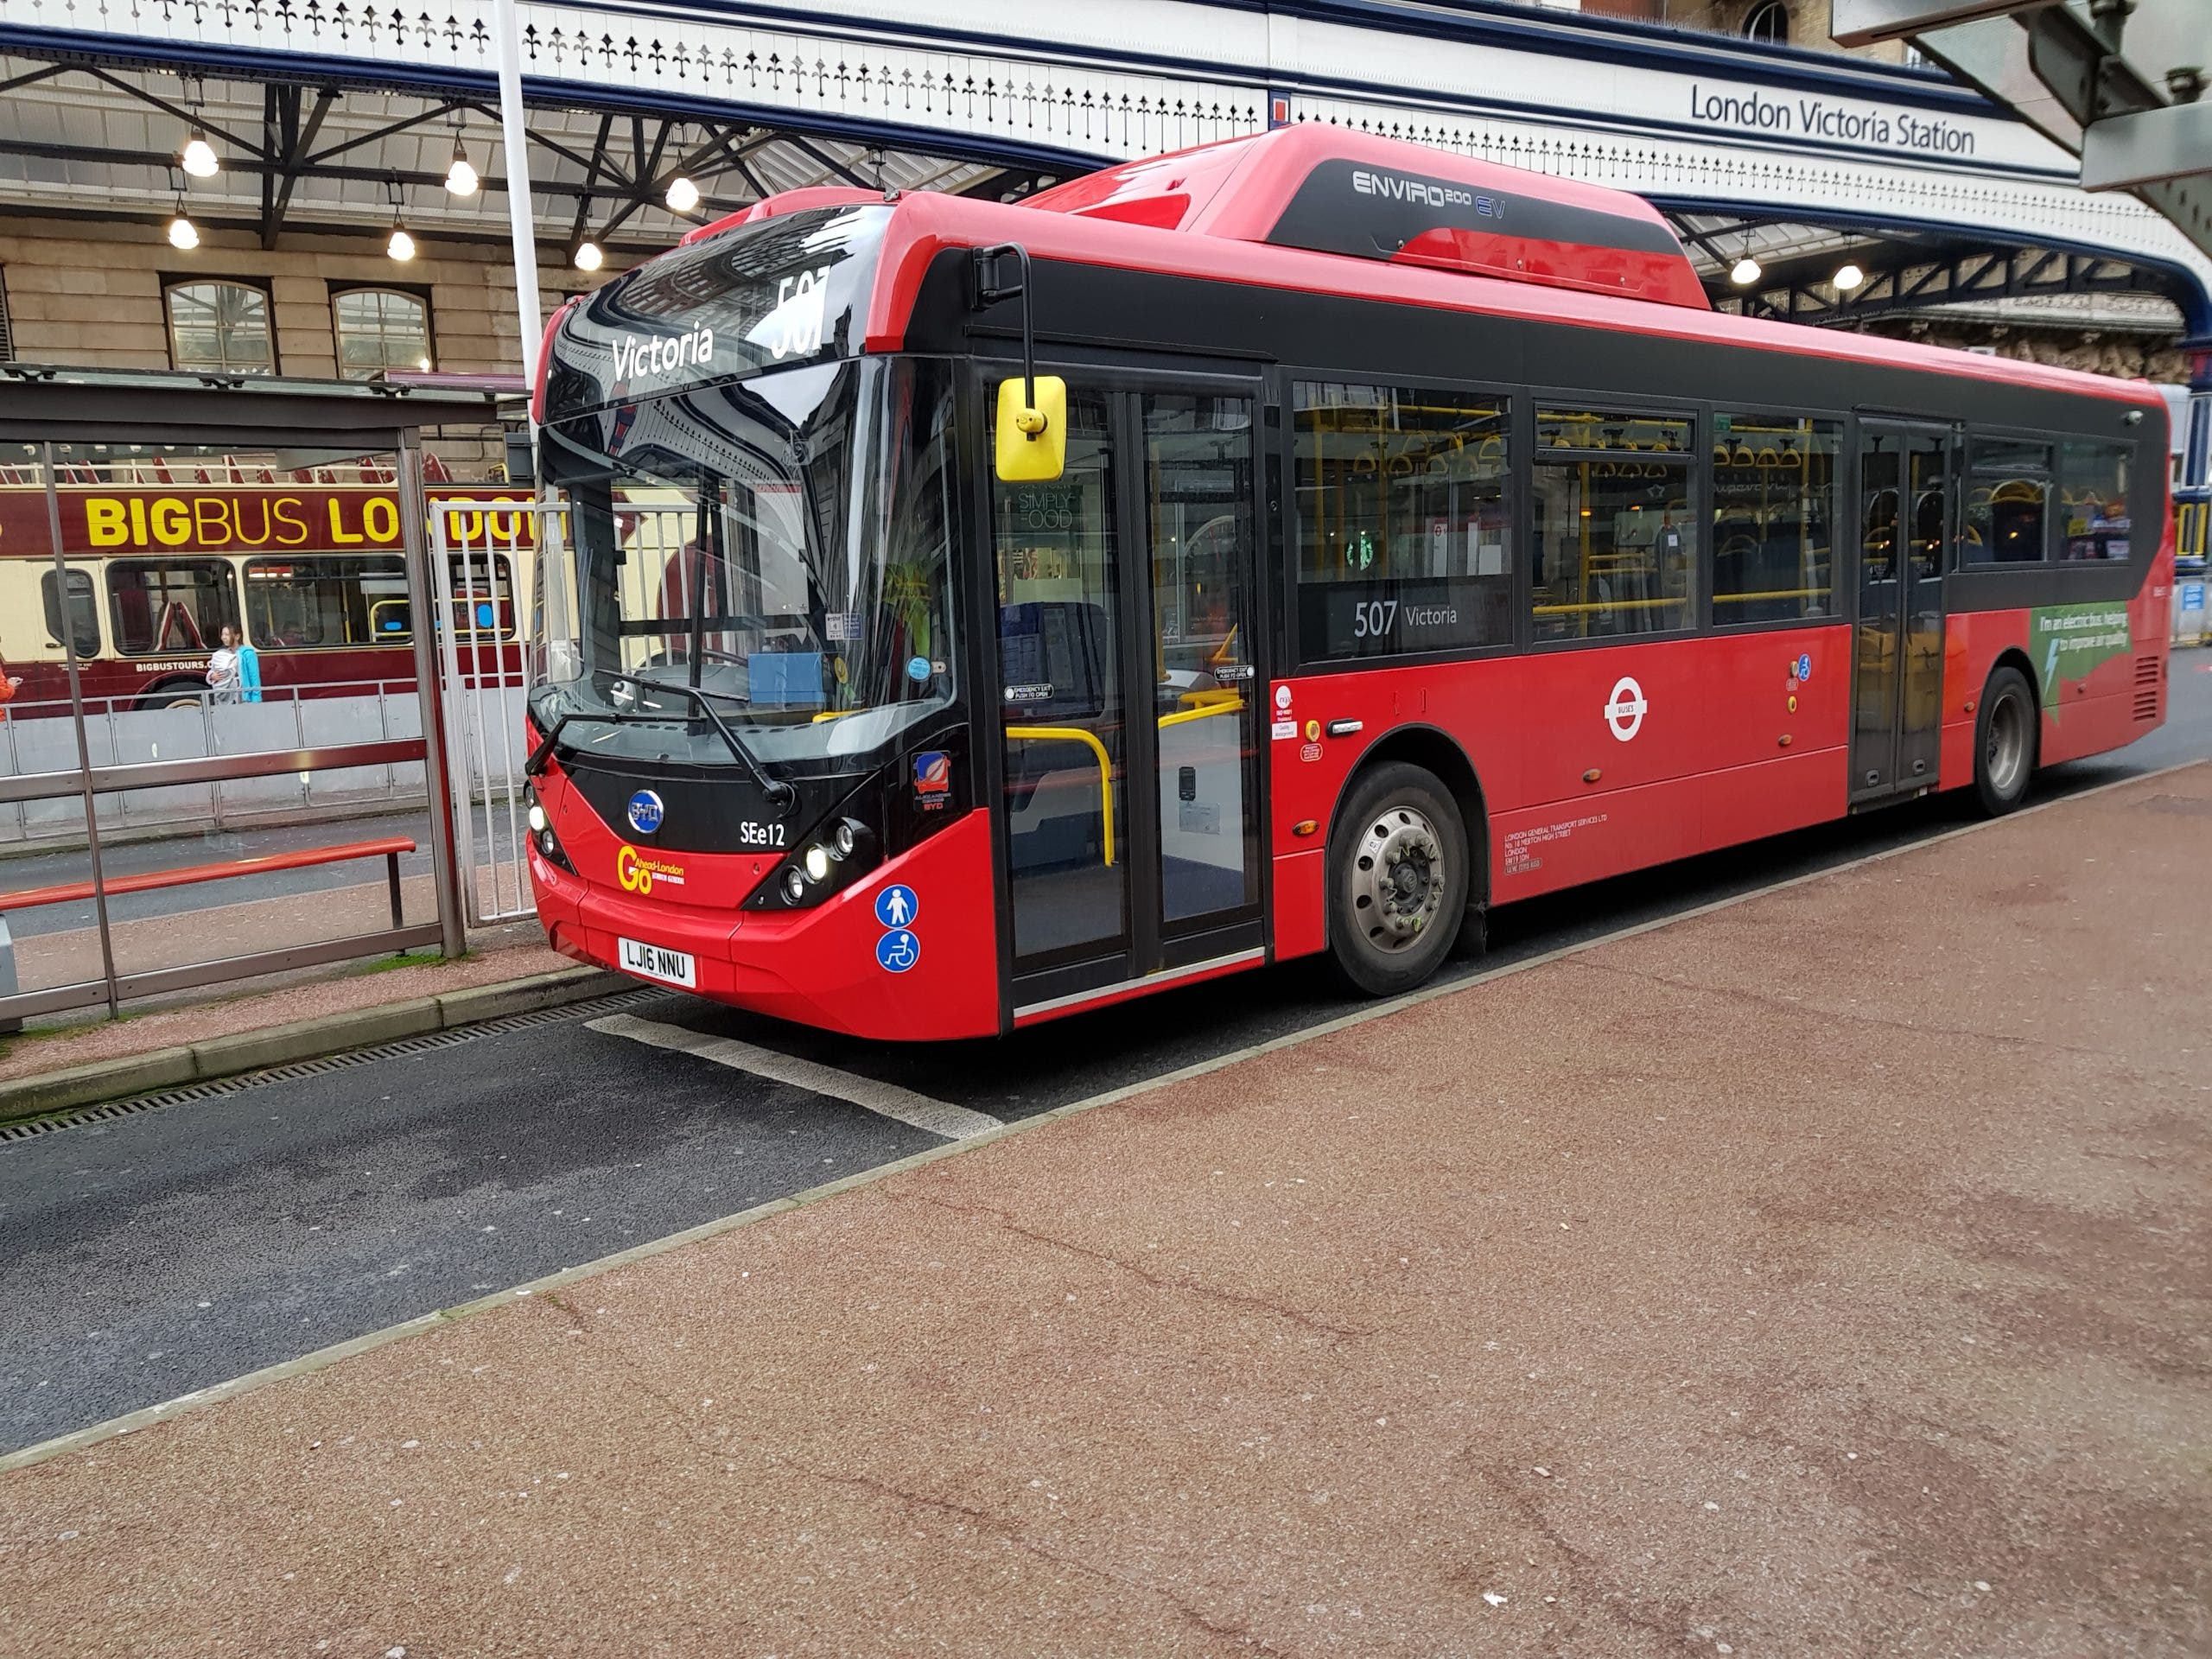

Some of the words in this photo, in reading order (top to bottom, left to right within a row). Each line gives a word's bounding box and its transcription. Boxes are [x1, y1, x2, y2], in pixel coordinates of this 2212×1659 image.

[1691, 84, 1790, 130] London
[1800, 99, 1890, 143] Victoria
[1897, 114, 1974, 155] Station
[1476, 195, 1505, 219] EV
[613, 320, 714, 382] Victoria
[1019, 493, 1071, 510] SIMPLY
[1354, 601, 1398, 638] 507
[1405, 606, 1458, 626] Victoria
[1618, 704, 1634, 715] BUSES
[631, 802, 658, 822] BYD
[924, 802, 944, 810] BYD
[741, 821, 785, 846] SEe12
[1504, 830, 1527, 842] LONDON
[1528, 827, 1549, 838] GENERAL
[1550, 819, 1577, 833] TRANSPORT
[1578, 816, 1598, 827] SERVICES
[1599, 814, 1608, 823] LTD
[1521, 835, 1541, 847] MERTON
[1541, 832, 1554, 843] HIGH
[1554, 830, 1571, 840] STREET
[1504, 846, 1528, 858] LONDON
[617, 845, 652, 895] Go
[626, 942, 654, 970] LJ16
[658, 954, 685, 979] NNU
